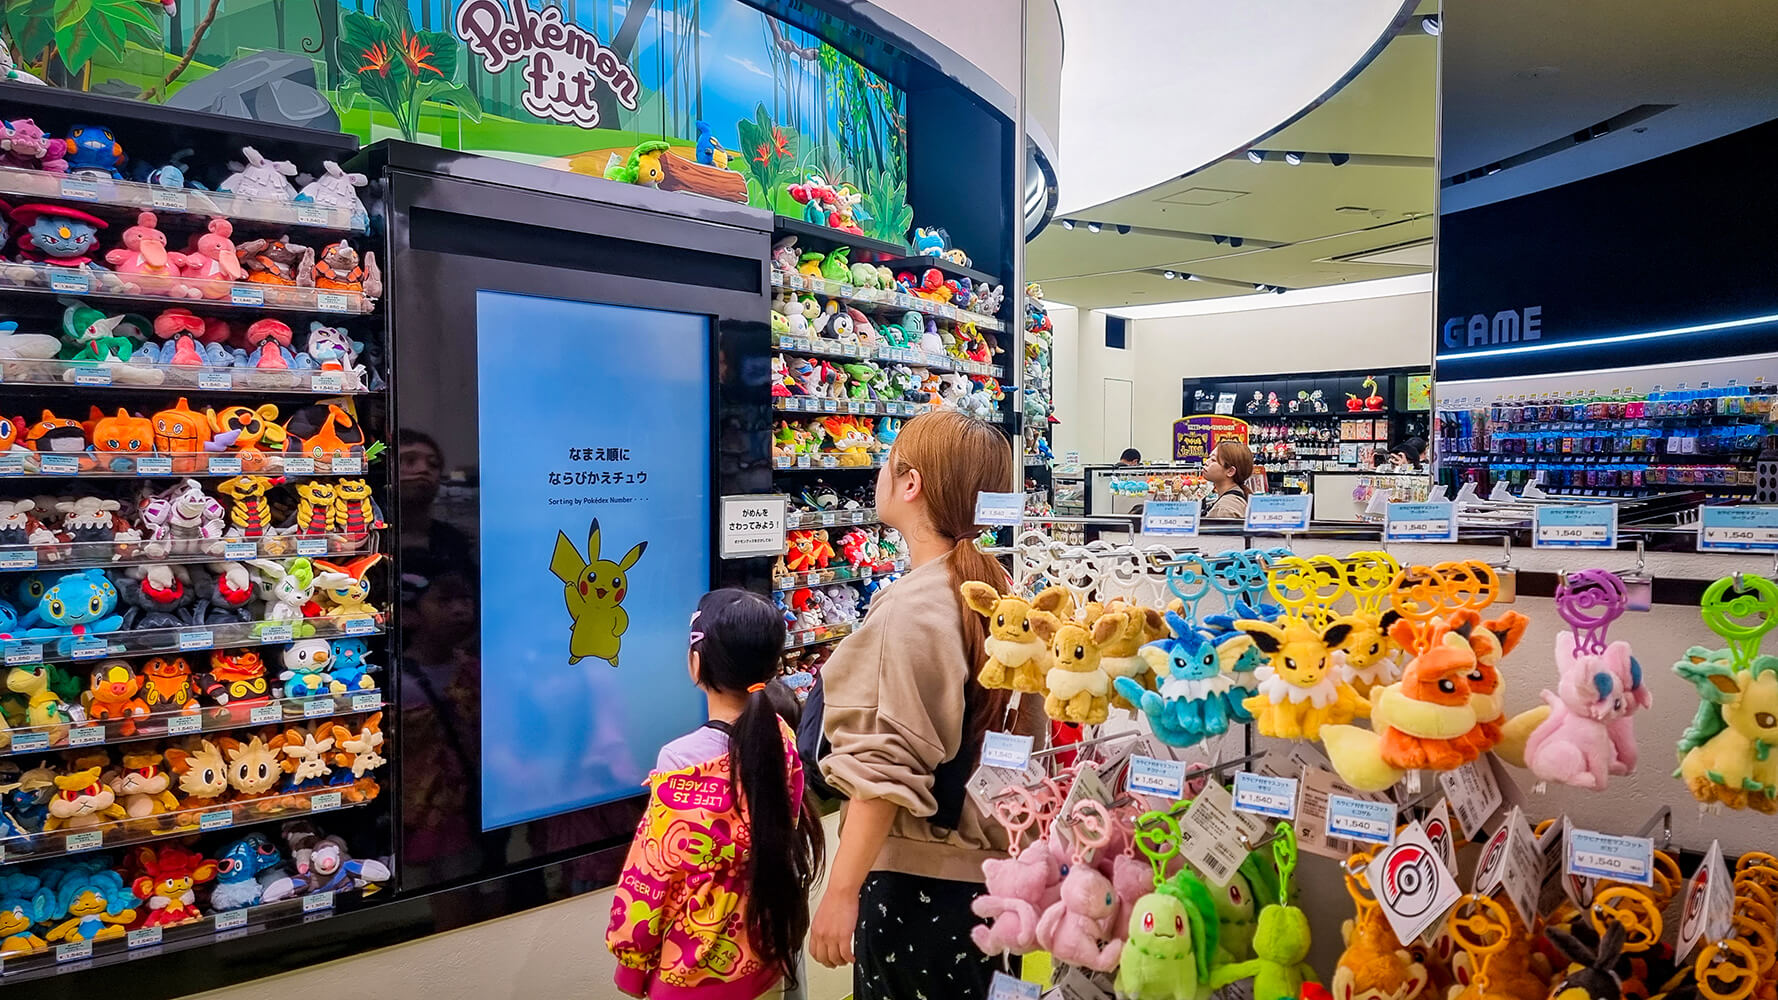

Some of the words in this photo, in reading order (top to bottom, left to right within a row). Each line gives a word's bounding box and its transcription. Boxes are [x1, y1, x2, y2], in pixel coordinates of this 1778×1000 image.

[459, 0, 639, 109] Pokémon
[528, 52, 597, 110] fit
[1443, 305, 1542, 349] GAME
[569, 448, 630, 462] なまえ順に
[548, 471, 647, 485] ならびかえチュウ
[548, 498, 573, 506] Sorting
[574, 498, 582, 506] by
[610, 496, 632, 504] Number
[742, 509, 768, 517] がめんを
[1142, 777, 1163, 785] 1,540
[723, 785, 730, 795] A
[673, 792, 690, 803] IS
[693, 794, 723, 807] LIFE
[1250, 794, 1272, 804] 1,540
[1345, 819, 1370, 830] 1,540
[1590, 856, 1621, 868] 1,540
[625, 875, 651, 896] CHEER
[652, 889, 666, 900] UP
